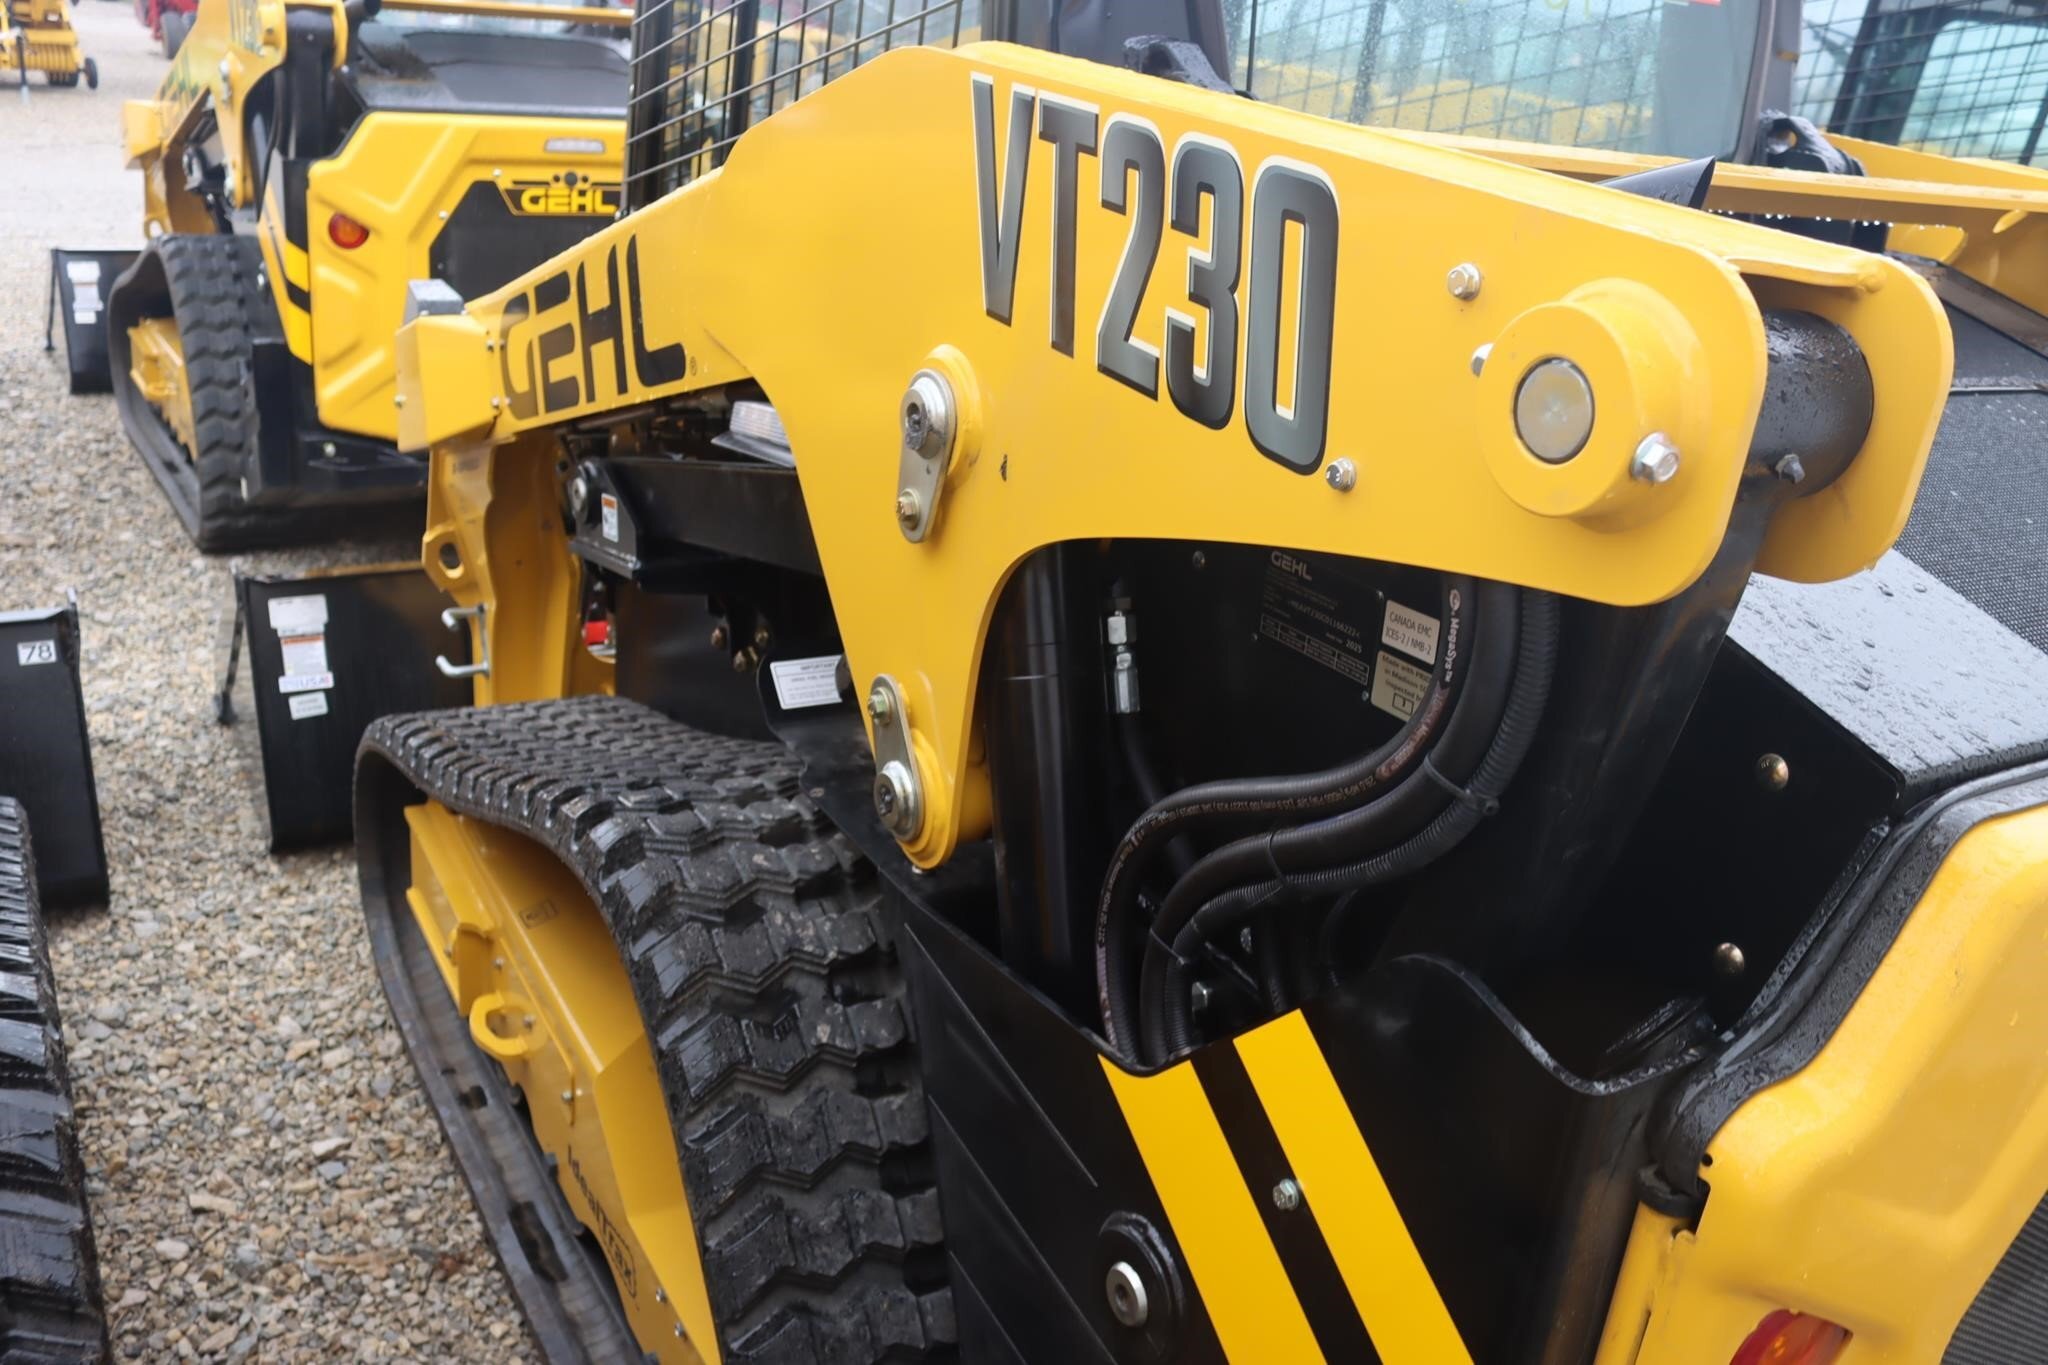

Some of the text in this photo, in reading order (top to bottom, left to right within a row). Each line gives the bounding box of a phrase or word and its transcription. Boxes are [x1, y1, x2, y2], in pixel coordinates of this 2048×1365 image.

[521, 188, 618, 213] GEHL
[970, 71, 1340, 476] VT230
[500, 234, 686, 420] GEHL
[1271, 551, 1312, 580] GEHL
[1389, 611, 1432, 638] CANADA EMC
[21, 642, 52, 663] 78
